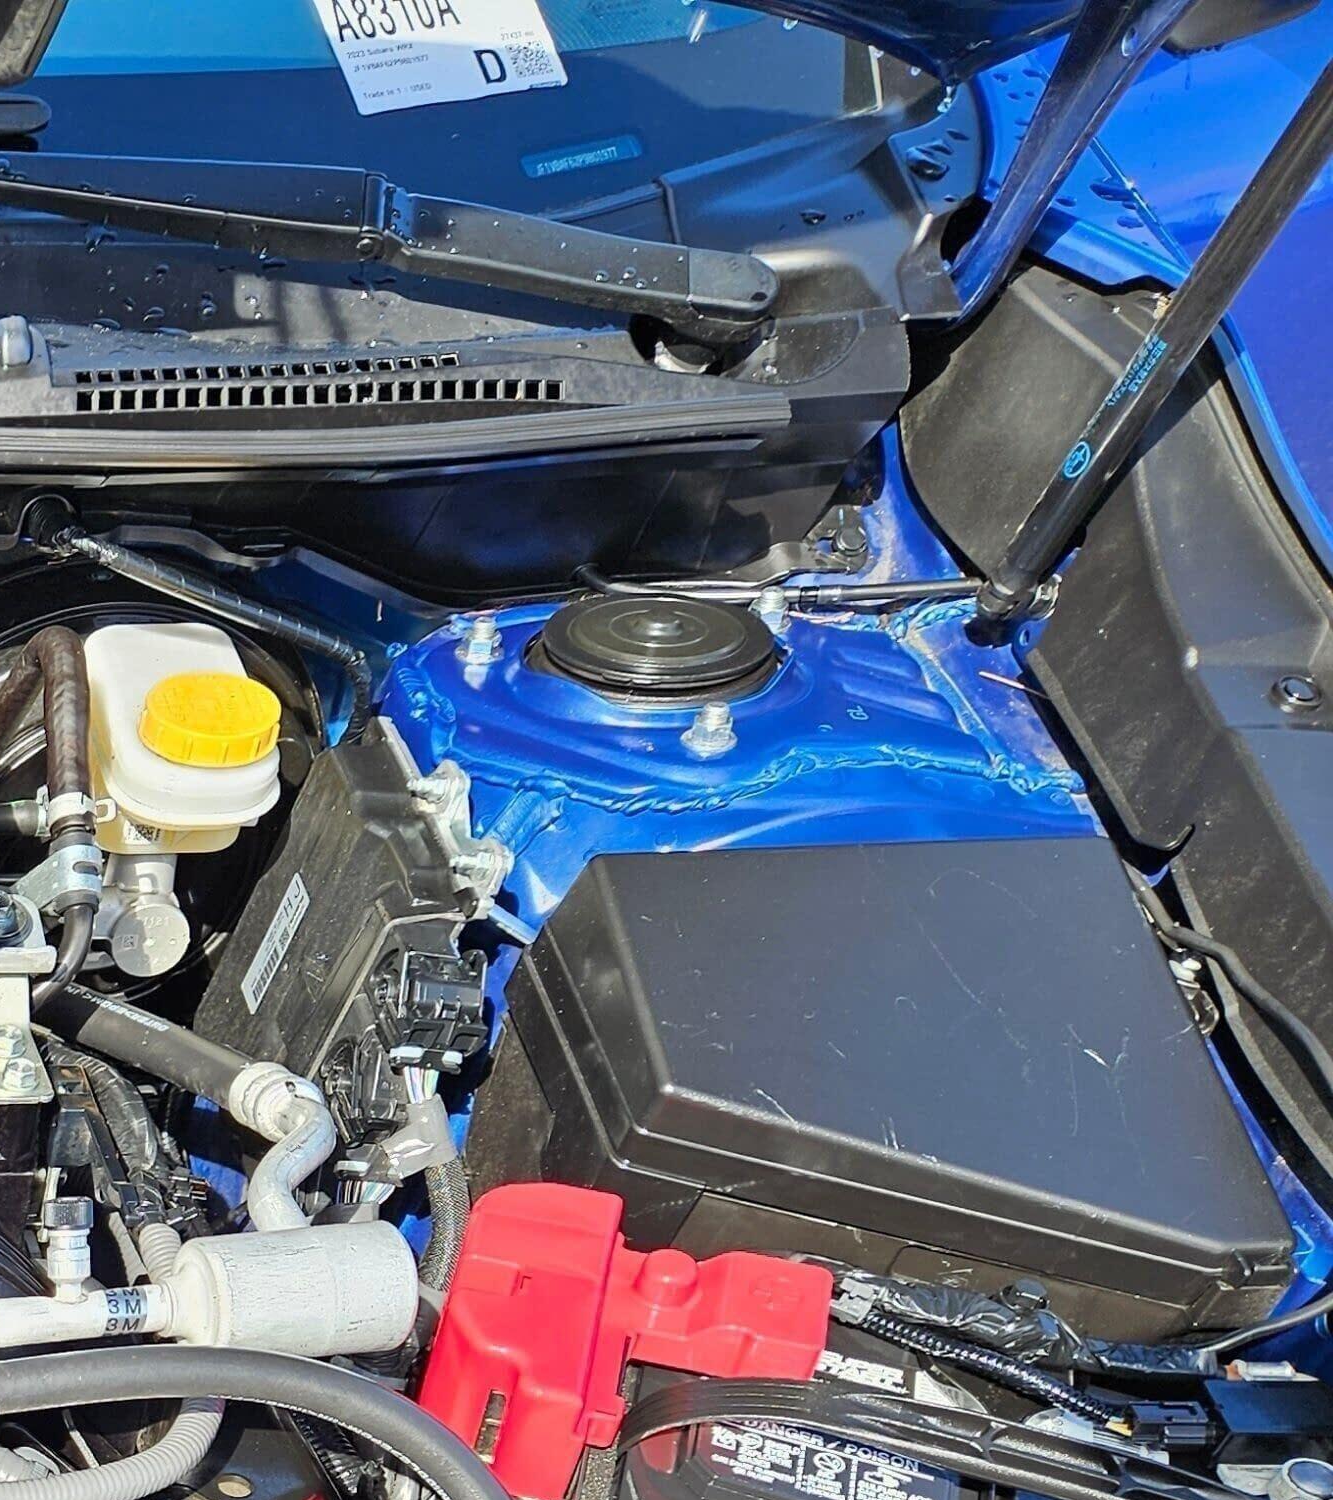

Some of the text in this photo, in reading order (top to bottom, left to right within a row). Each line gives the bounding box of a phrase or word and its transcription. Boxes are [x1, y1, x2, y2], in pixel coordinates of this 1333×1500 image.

[473, 49, 507, 84] D
[107, 1299, 141, 1315] 3 M
[121, 1317, 141, 1332] M
[843, 1443, 920, 1472] POISON
